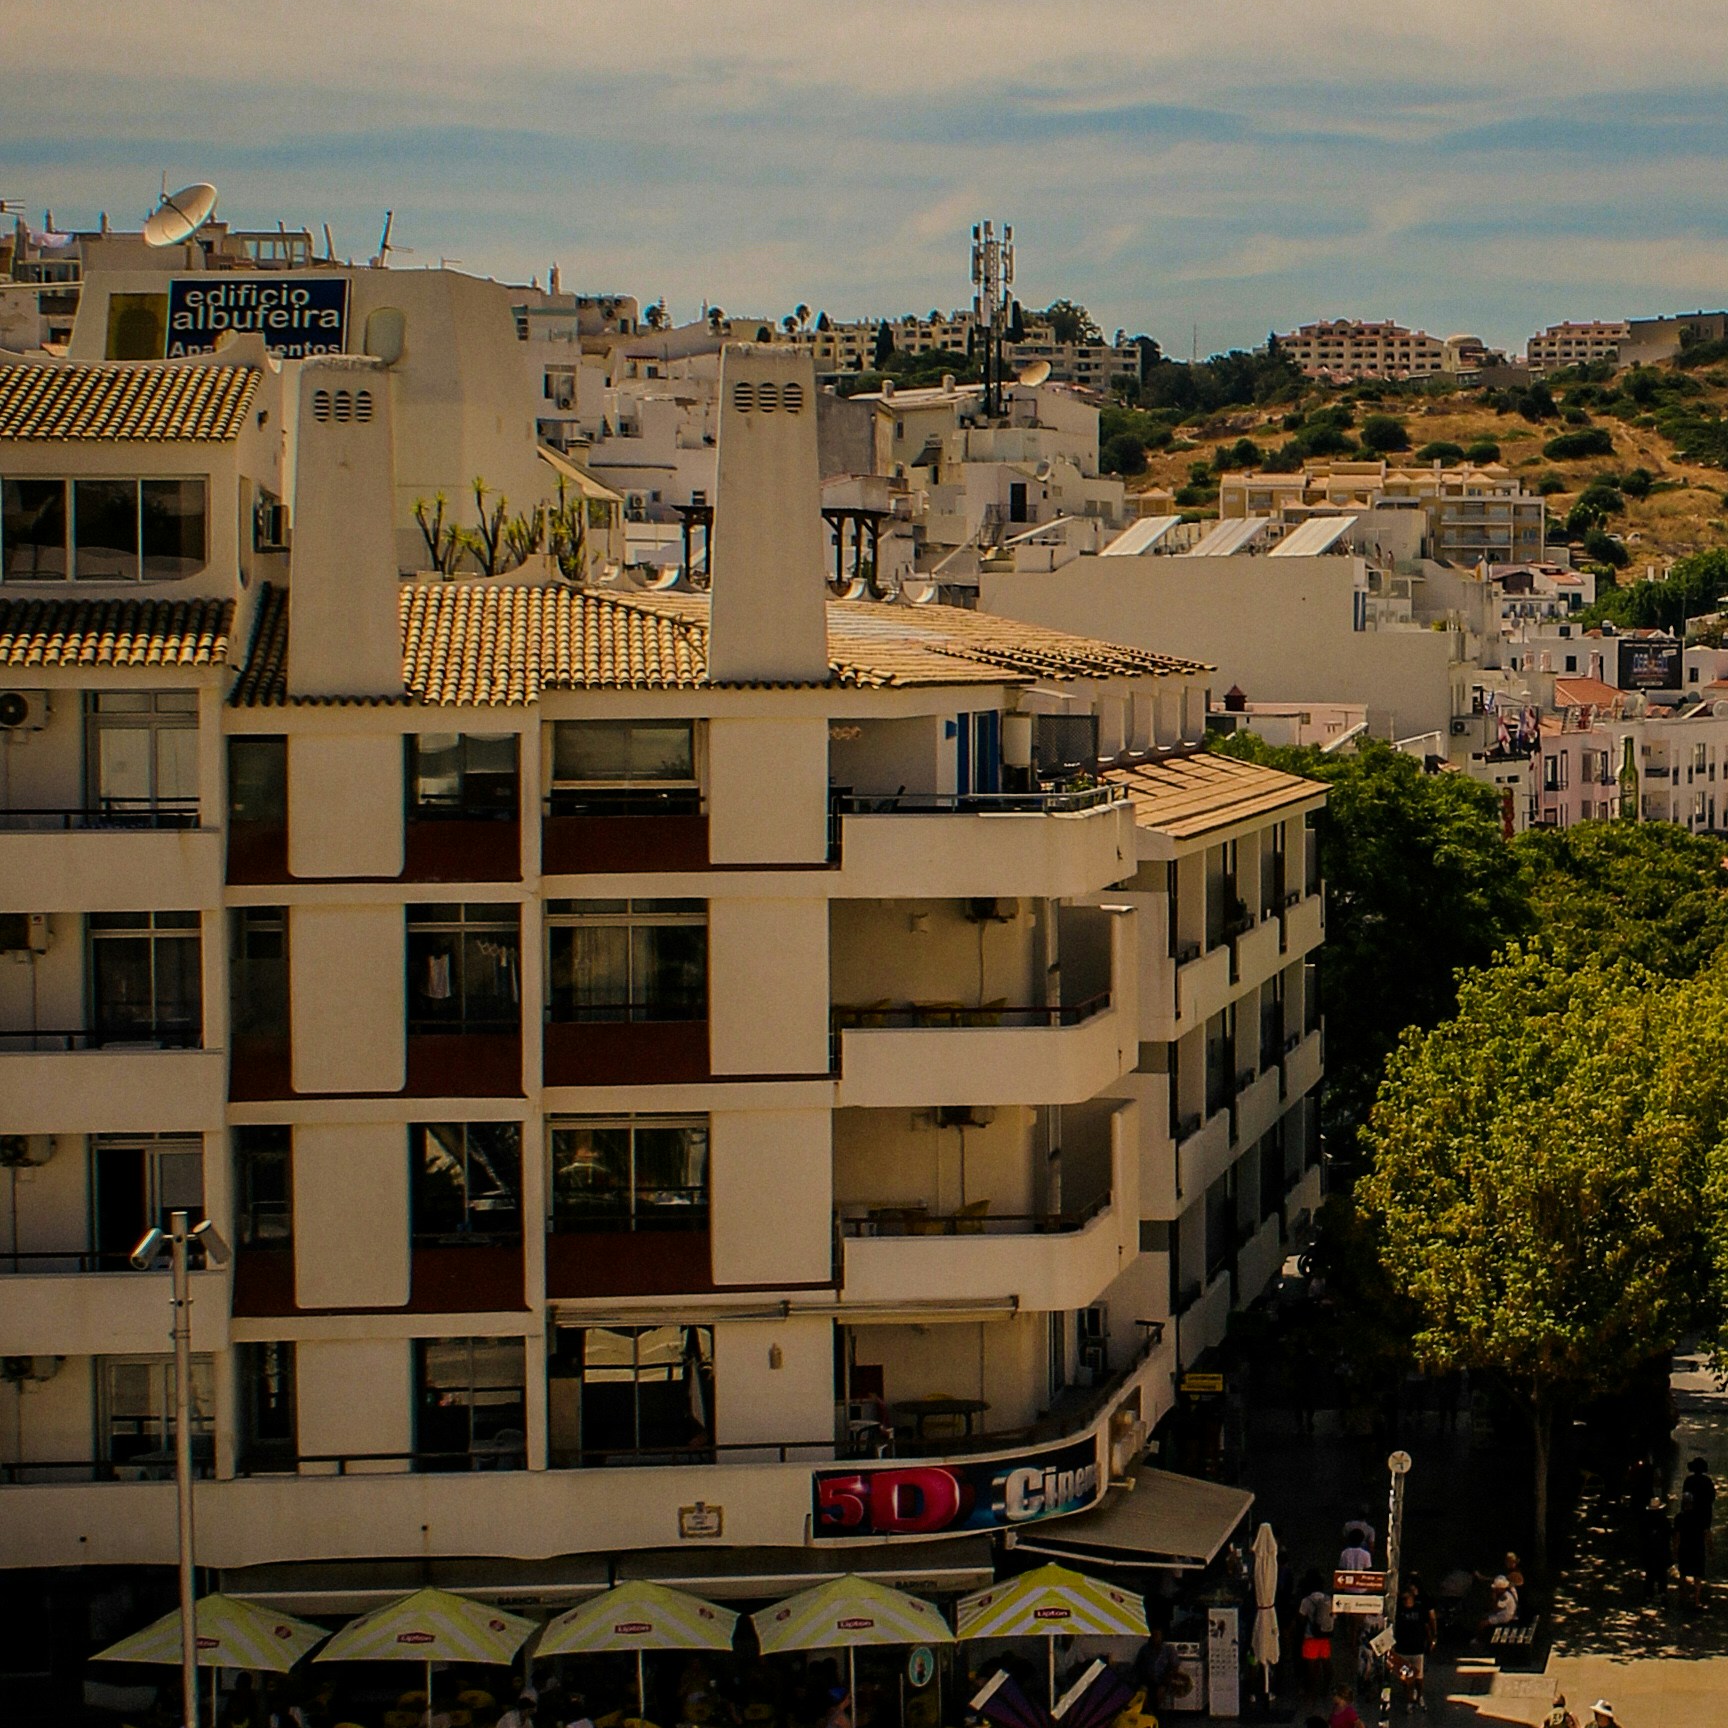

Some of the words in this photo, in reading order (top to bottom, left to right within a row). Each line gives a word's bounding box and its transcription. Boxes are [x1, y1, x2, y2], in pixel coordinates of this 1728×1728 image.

[172, 303, 341, 330] albufeira
[819, 1467, 962, 1533] 5D
[1036, 1609, 1068, 1618] Lipton
[839, 1620, 872, 1629] Lipton
